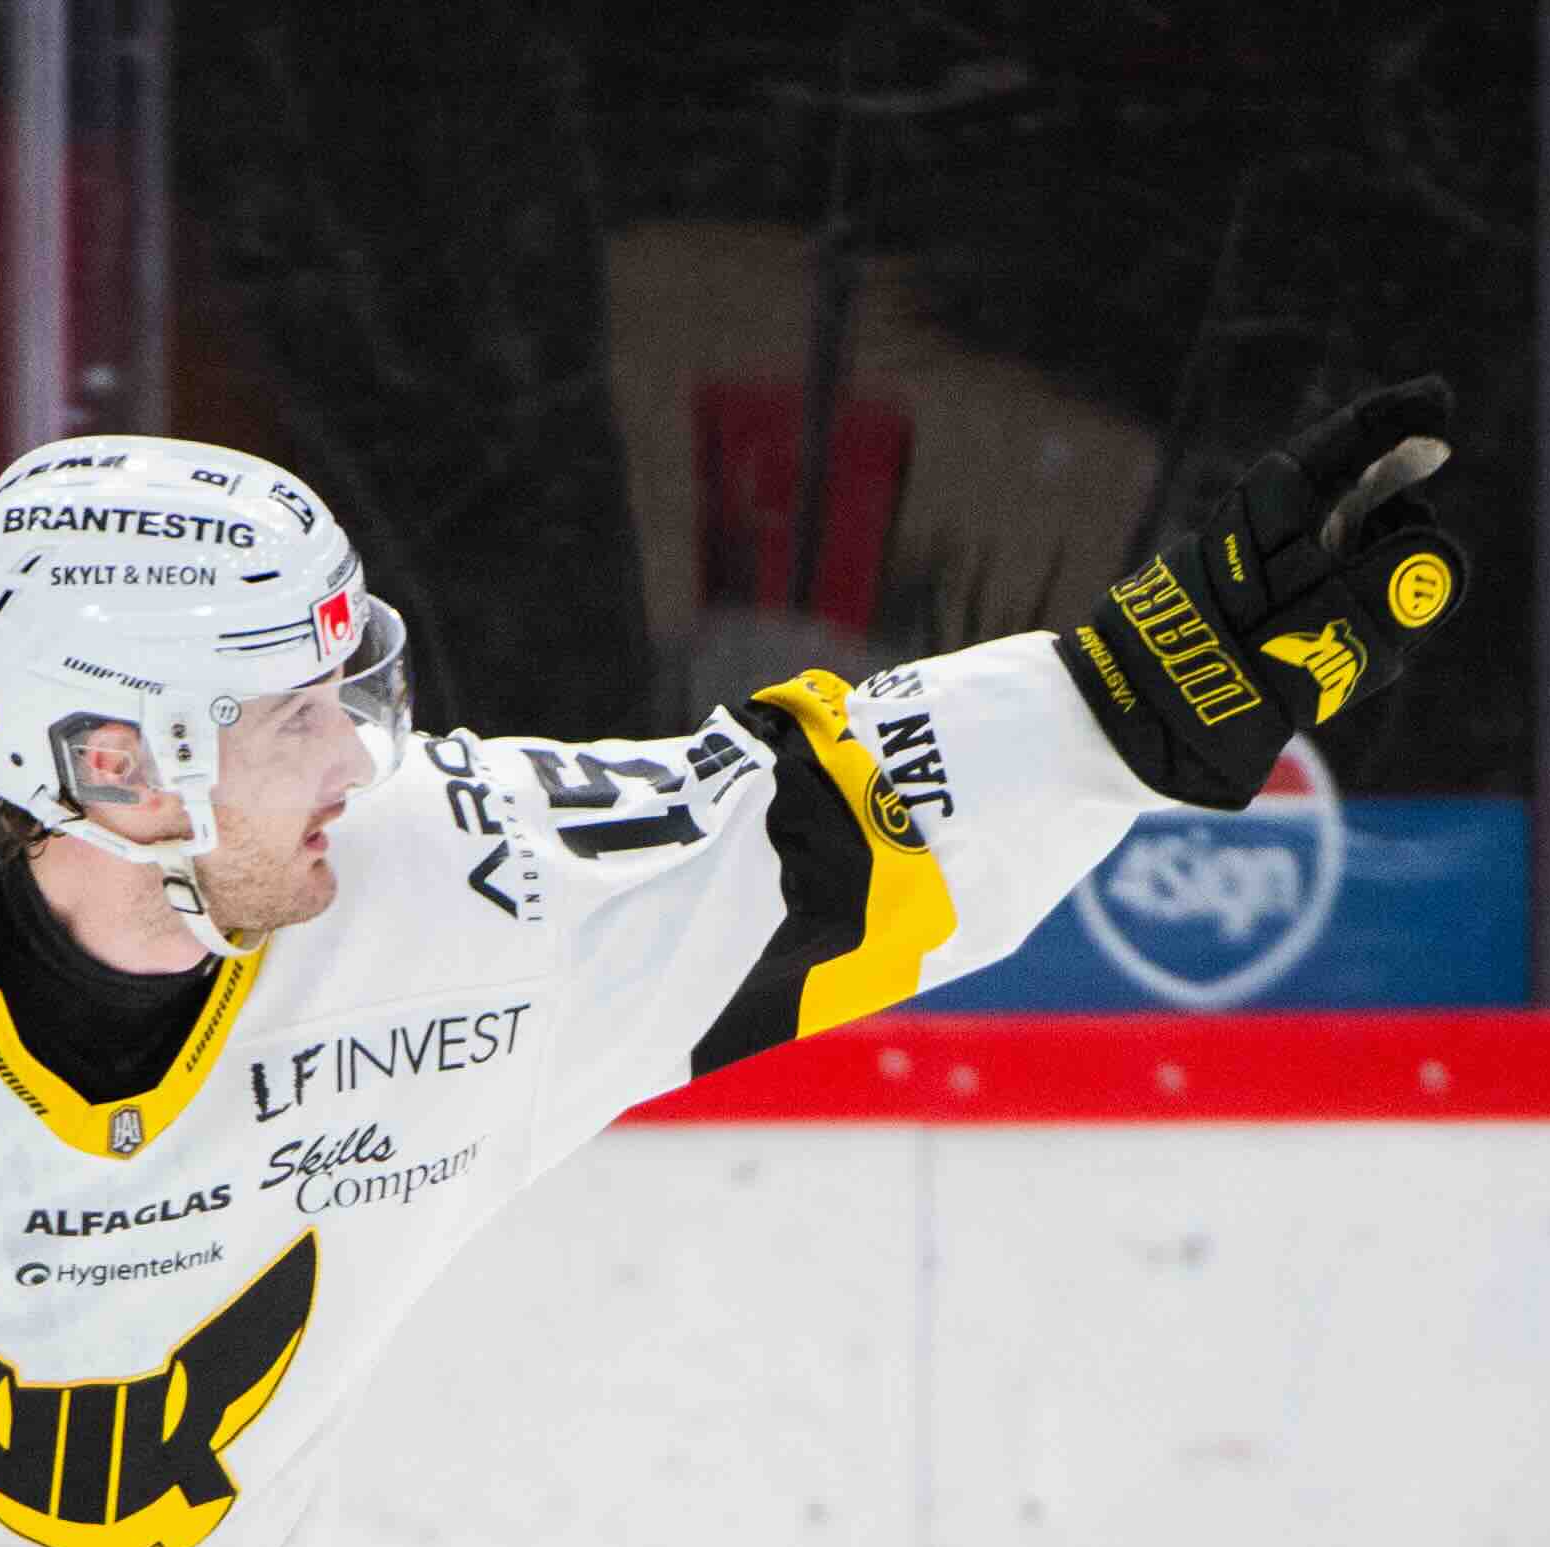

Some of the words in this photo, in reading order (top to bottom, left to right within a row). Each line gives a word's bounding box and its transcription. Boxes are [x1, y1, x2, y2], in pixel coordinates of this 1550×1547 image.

[3, 506, 255, 549] BRANTESTIG
[51, 566, 117, 586] SKYLT
[122, 568, 139, 586] &
[147, 567, 217, 587] NEON
[877, 712, 954, 818] JAN
[1111, 828, 1303, 937] 4Sign
[259, 1123, 397, 1190] Skills
[23, 1183, 233, 1237] ALFAGLAS
[56, 1240, 225, 1287] Hygienteknik
